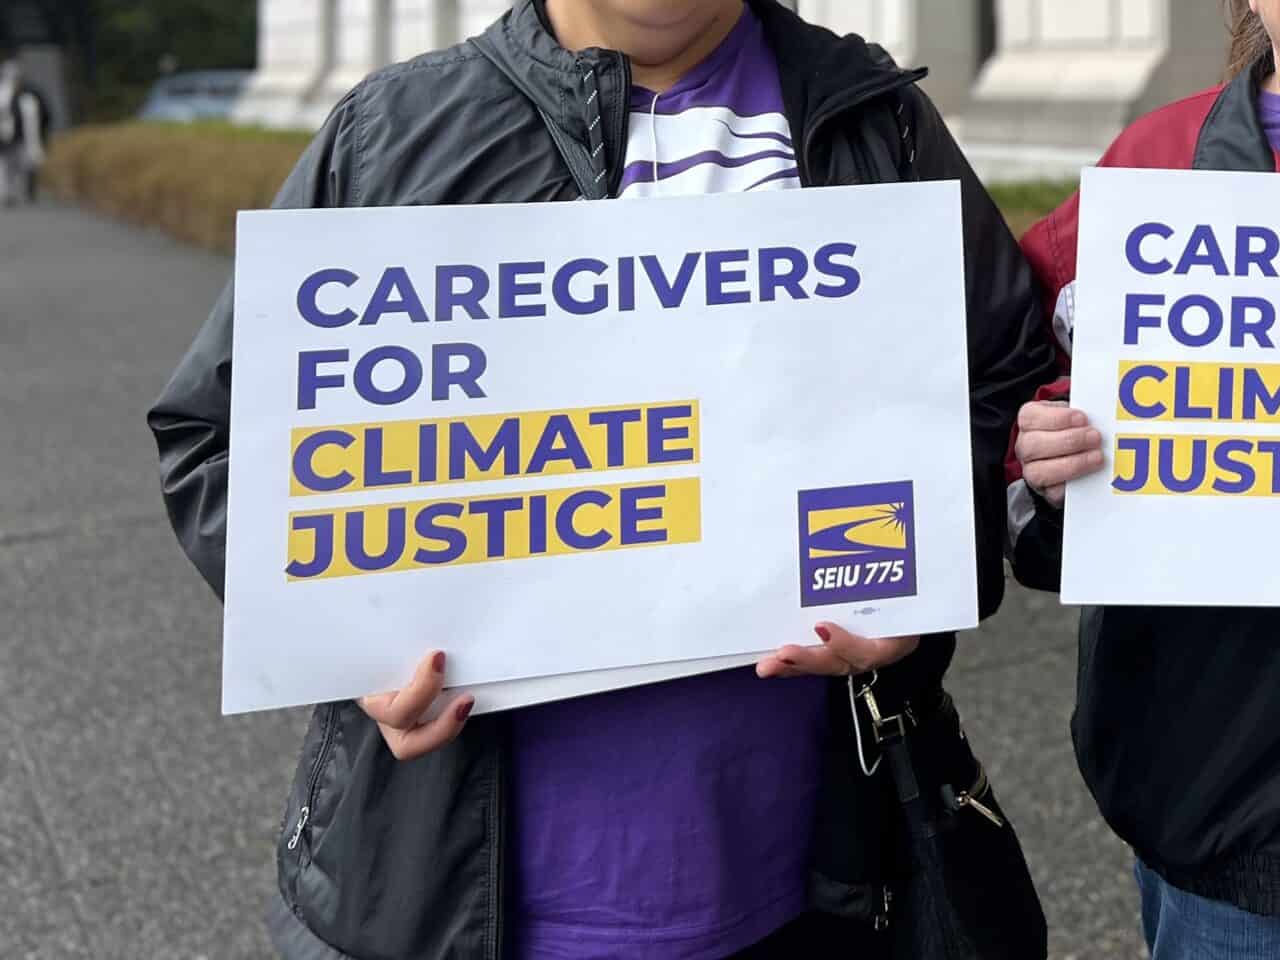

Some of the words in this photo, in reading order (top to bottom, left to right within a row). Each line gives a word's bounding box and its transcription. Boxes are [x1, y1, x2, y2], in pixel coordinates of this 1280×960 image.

[297, 243, 861, 328] CAREGIVERS
[1123, 294, 1276, 348] FOR
[297, 342, 487, 410] FOR
[292, 405, 694, 491] CLIMATE
[286, 485, 668, 578] JUSTICE
[812, 565, 861, 591] SEIU
[863, 560, 905, 585] 775
